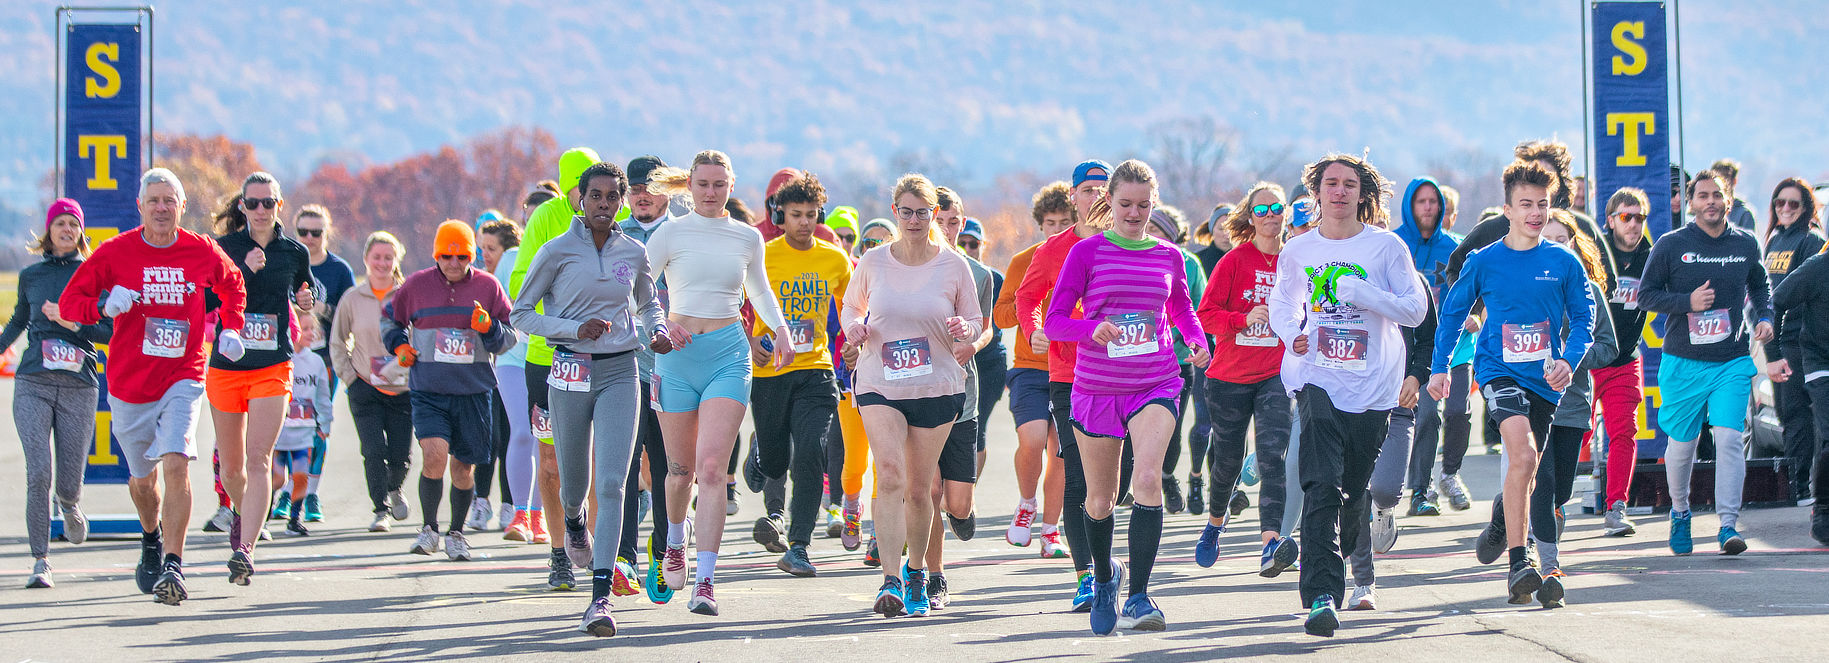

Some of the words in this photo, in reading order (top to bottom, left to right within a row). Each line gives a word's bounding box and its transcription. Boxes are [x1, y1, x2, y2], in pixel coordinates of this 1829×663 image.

[1681, 252, 1747, 267] Champion
[143, 270, 185, 282] run
[1255, 272, 1276, 286] ru
[1331, 261, 1367, 281] CHAMPION
[143, 281, 186, 294] santa
[780, 280, 831, 297] CAMEL
[143, 293, 184, 305] run
[779, 296, 823, 313] TROT
[245, 322, 270, 340] 383
[1118, 323, 1148, 344] 392
[1247, 322, 1270, 337] 384
[1698, 319, 1721, 335] 372
[155, 328, 181, 347] 358
[792, 328, 806, 343] 66
[1513, 333, 1541, 351] 399
[52, 345, 76, 361] 398
[444, 338, 467, 354] 396
[1328, 338, 1356, 358] 382
[892, 348, 920, 368] 393
[553, 360, 580, 380] 390
[538, 416, 553, 431] 36
